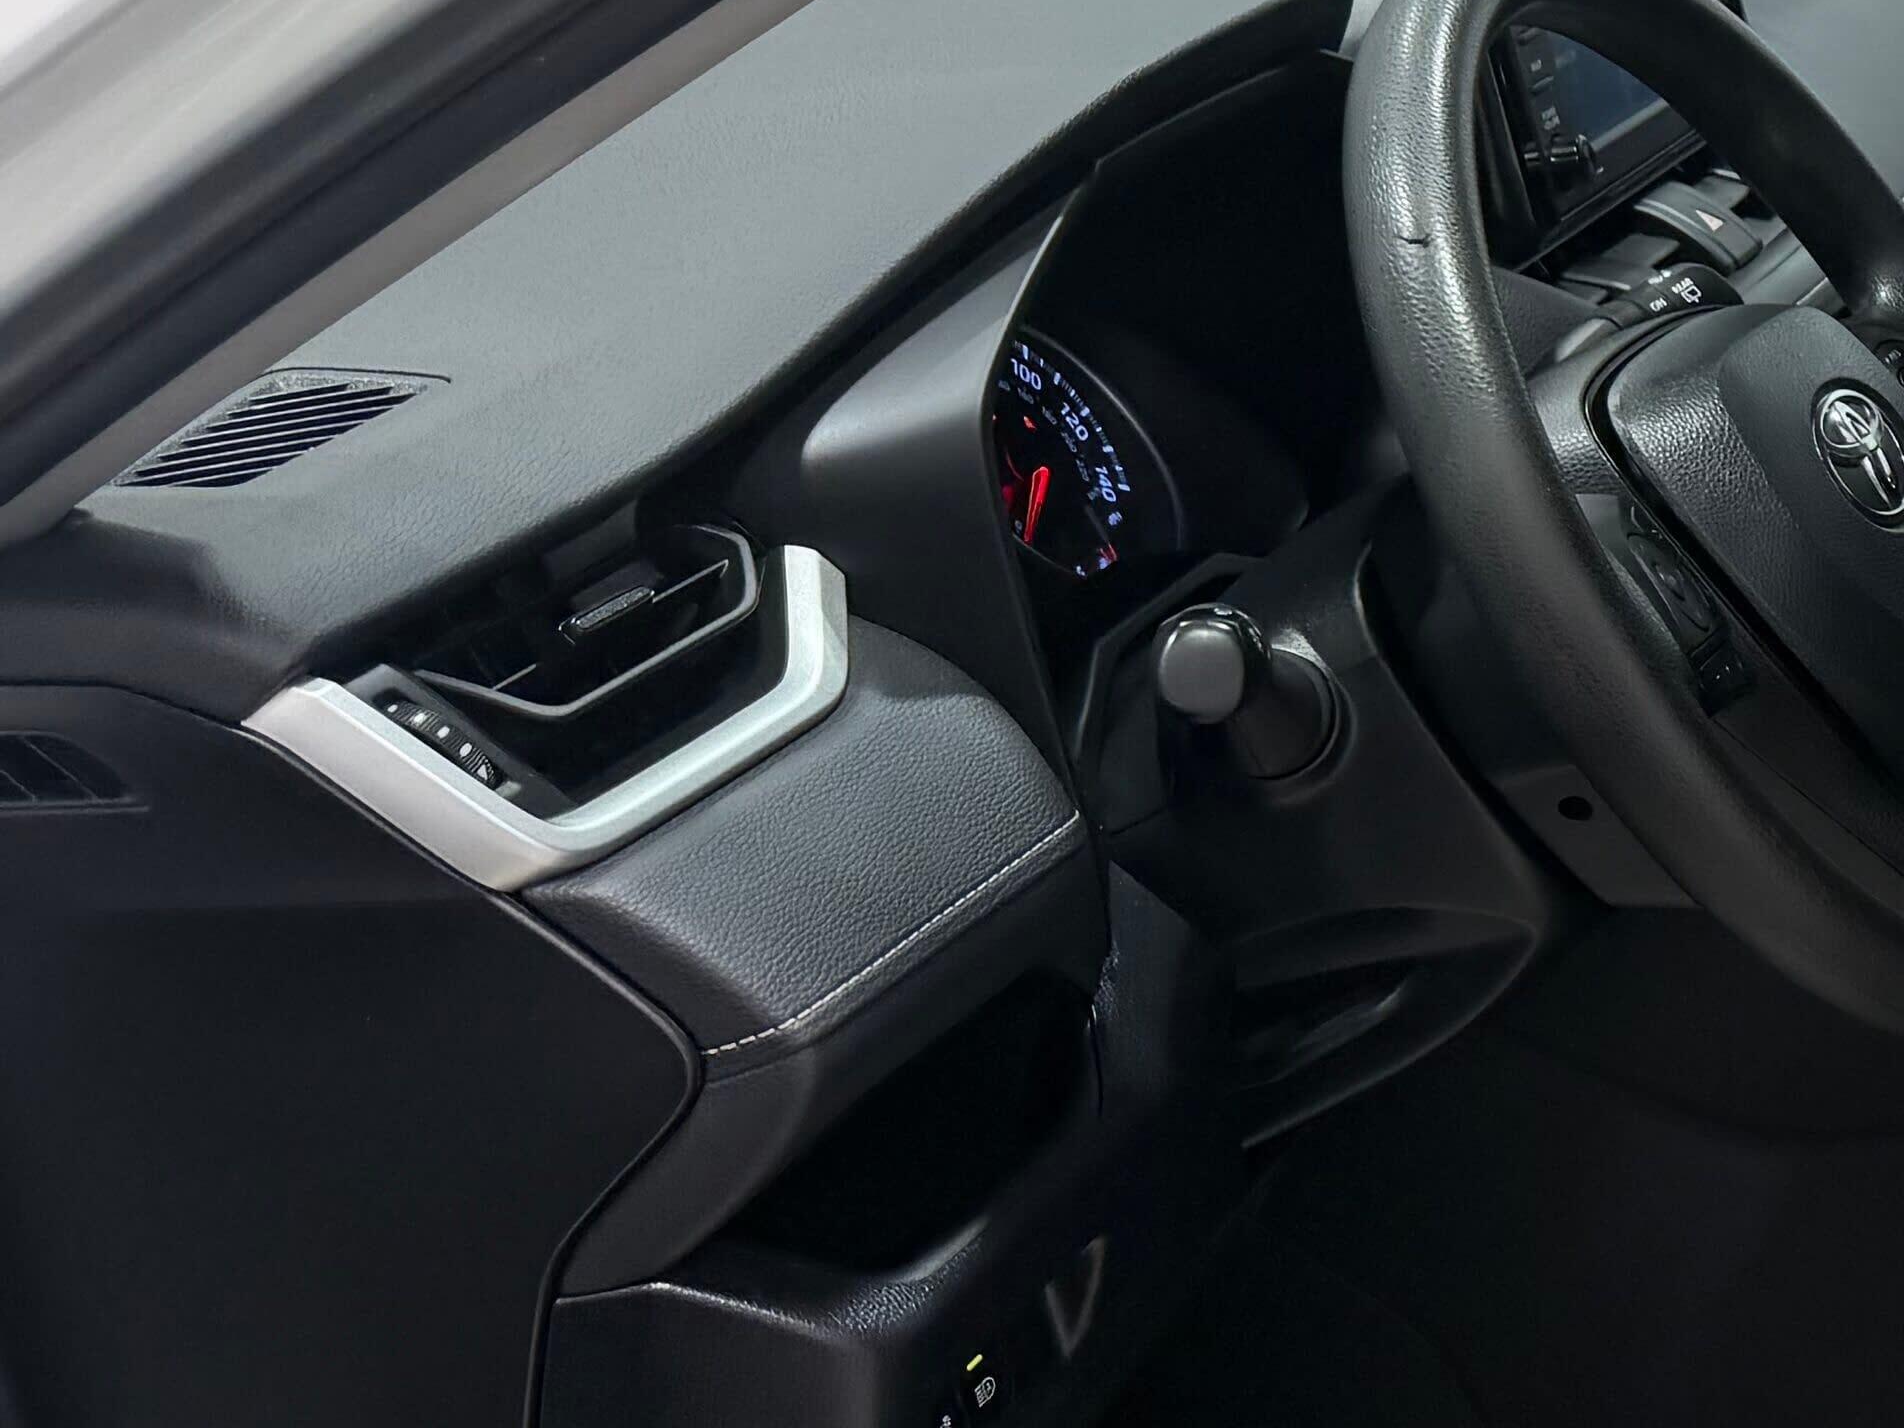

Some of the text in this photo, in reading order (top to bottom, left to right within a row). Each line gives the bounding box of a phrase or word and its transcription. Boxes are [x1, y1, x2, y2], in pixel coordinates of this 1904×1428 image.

[1011, 358, 1042, 391] 100
[1061, 402, 1089, 442] 120
[1095, 466, 1117, 503] 140
